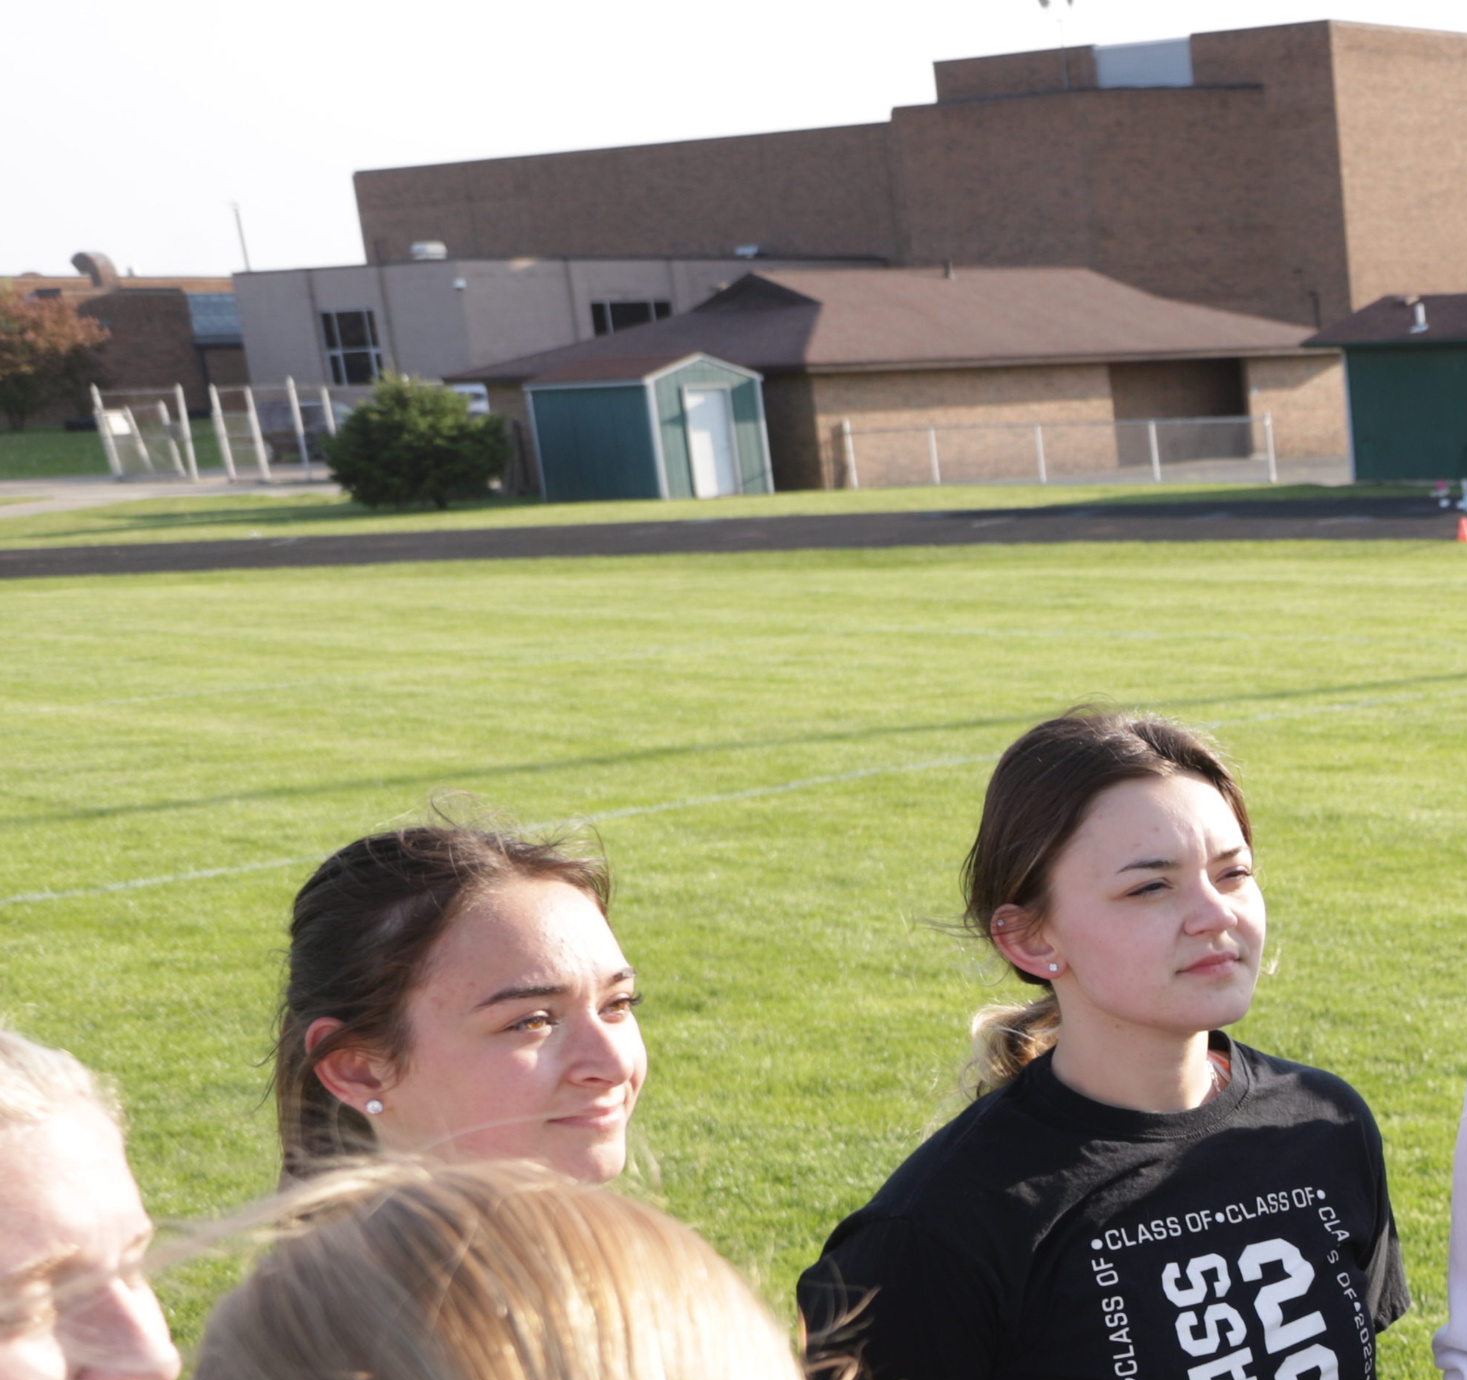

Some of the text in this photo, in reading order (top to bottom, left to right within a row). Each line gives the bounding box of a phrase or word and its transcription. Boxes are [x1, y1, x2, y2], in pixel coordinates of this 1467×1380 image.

[1105, 1186, 1316, 1251] CLASS OF CLASS OF
[1318, 1206, 1350, 1265] CLAS
[1091, 1256, 1119, 1287] OF
[1102, 1295, 1139, 1377] CLASS
